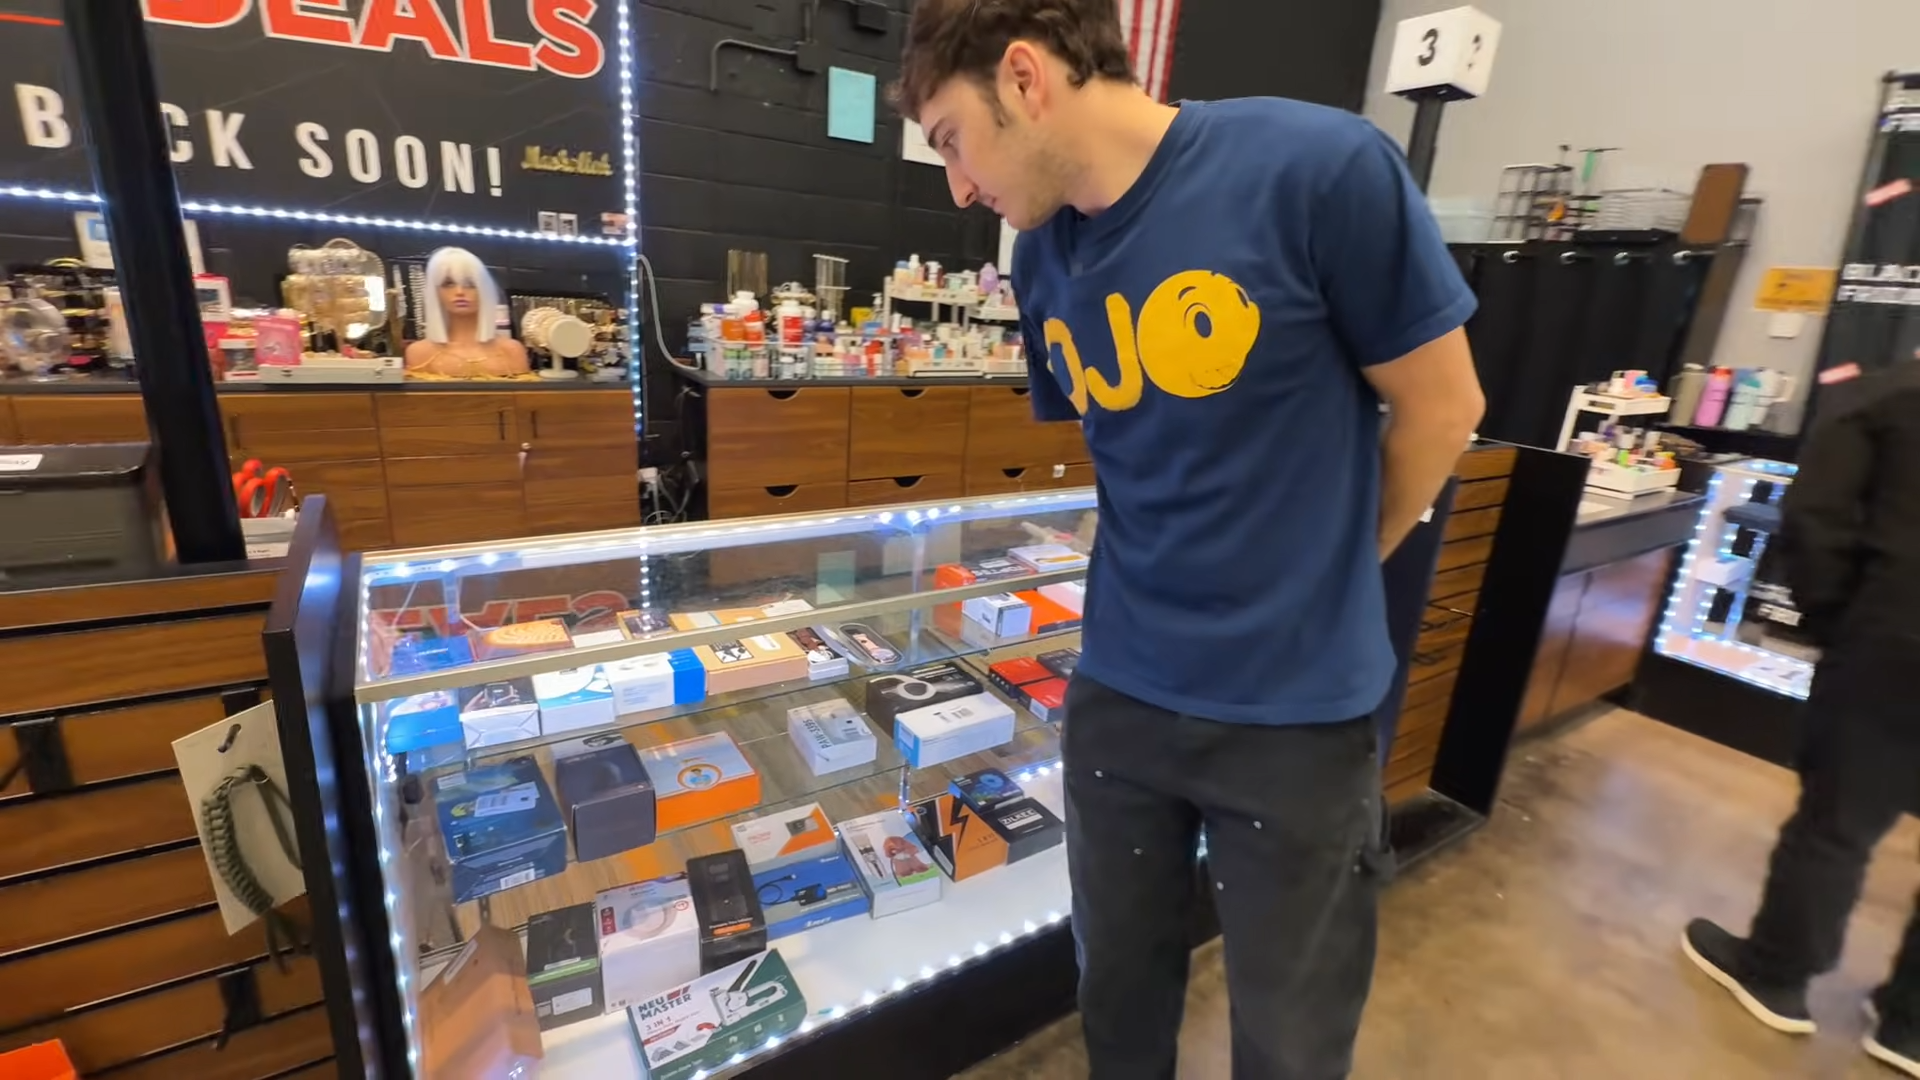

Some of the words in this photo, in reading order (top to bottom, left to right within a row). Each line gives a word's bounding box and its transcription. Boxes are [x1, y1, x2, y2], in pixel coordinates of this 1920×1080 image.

[1418, 27, 1439, 67] 3
[14, 83, 254, 170] BCK
[294, 121, 503, 198] SOON!
[638, 997, 665, 1013] NEU
[640, 993, 692, 1021] MASTER
[653, 1019, 664, 1029] IN
